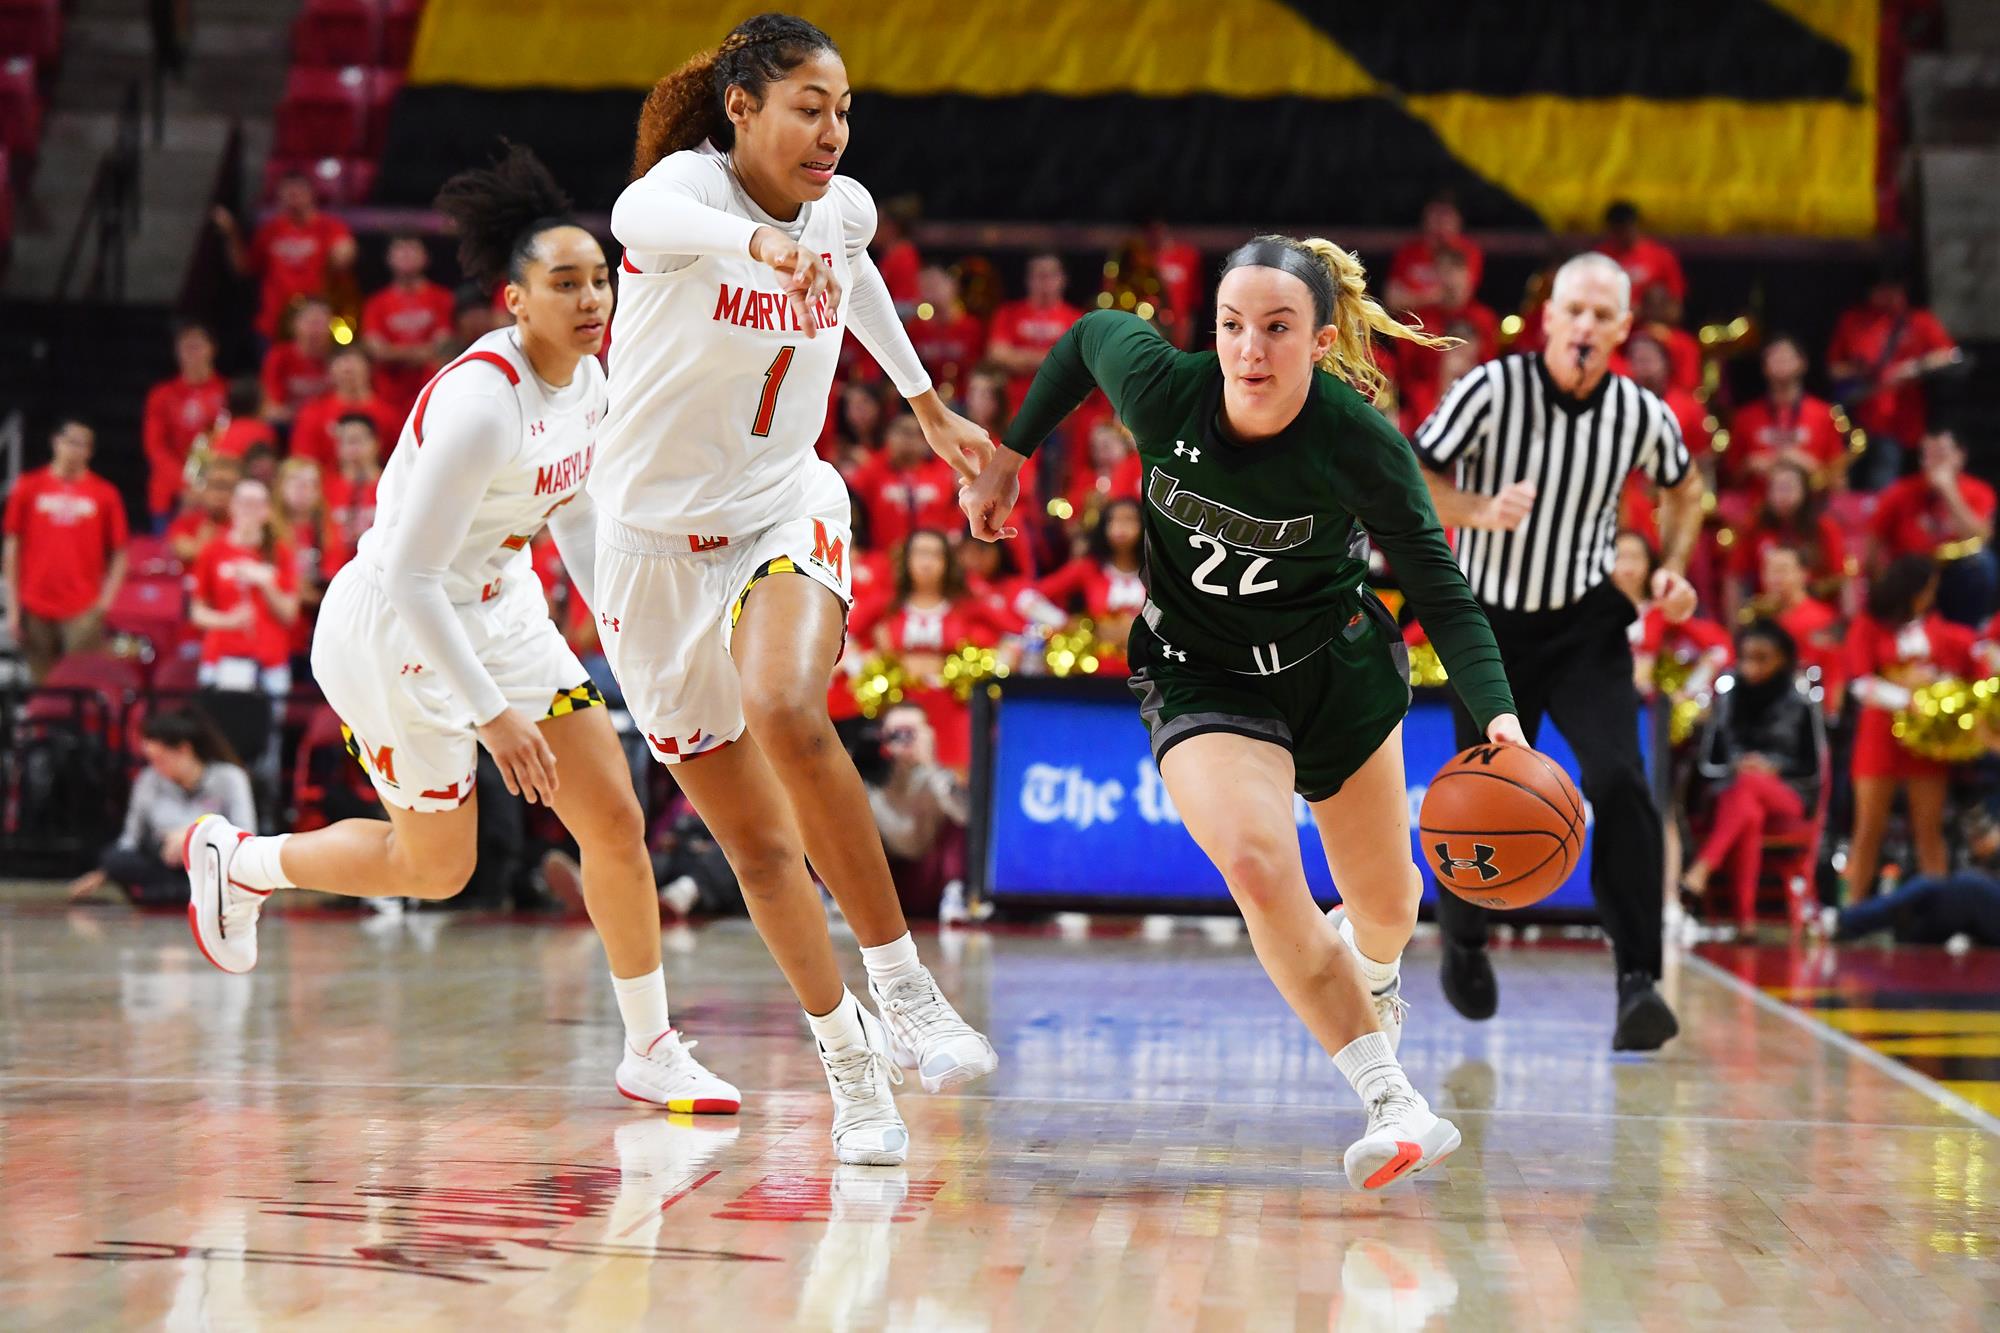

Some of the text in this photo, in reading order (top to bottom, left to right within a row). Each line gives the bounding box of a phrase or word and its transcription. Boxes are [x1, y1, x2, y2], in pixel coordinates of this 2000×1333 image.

[713, 283, 839, 331] MARYLN
[751, 346, 796, 437] 1
[534, 440, 596, 496] MARYLA
[1148, 466, 1313, 551] LOYOLA
[810, 517, 845, 586] M
[1189, 534, 1279, 596] 22
[1020, 762, 1124, 830] The
